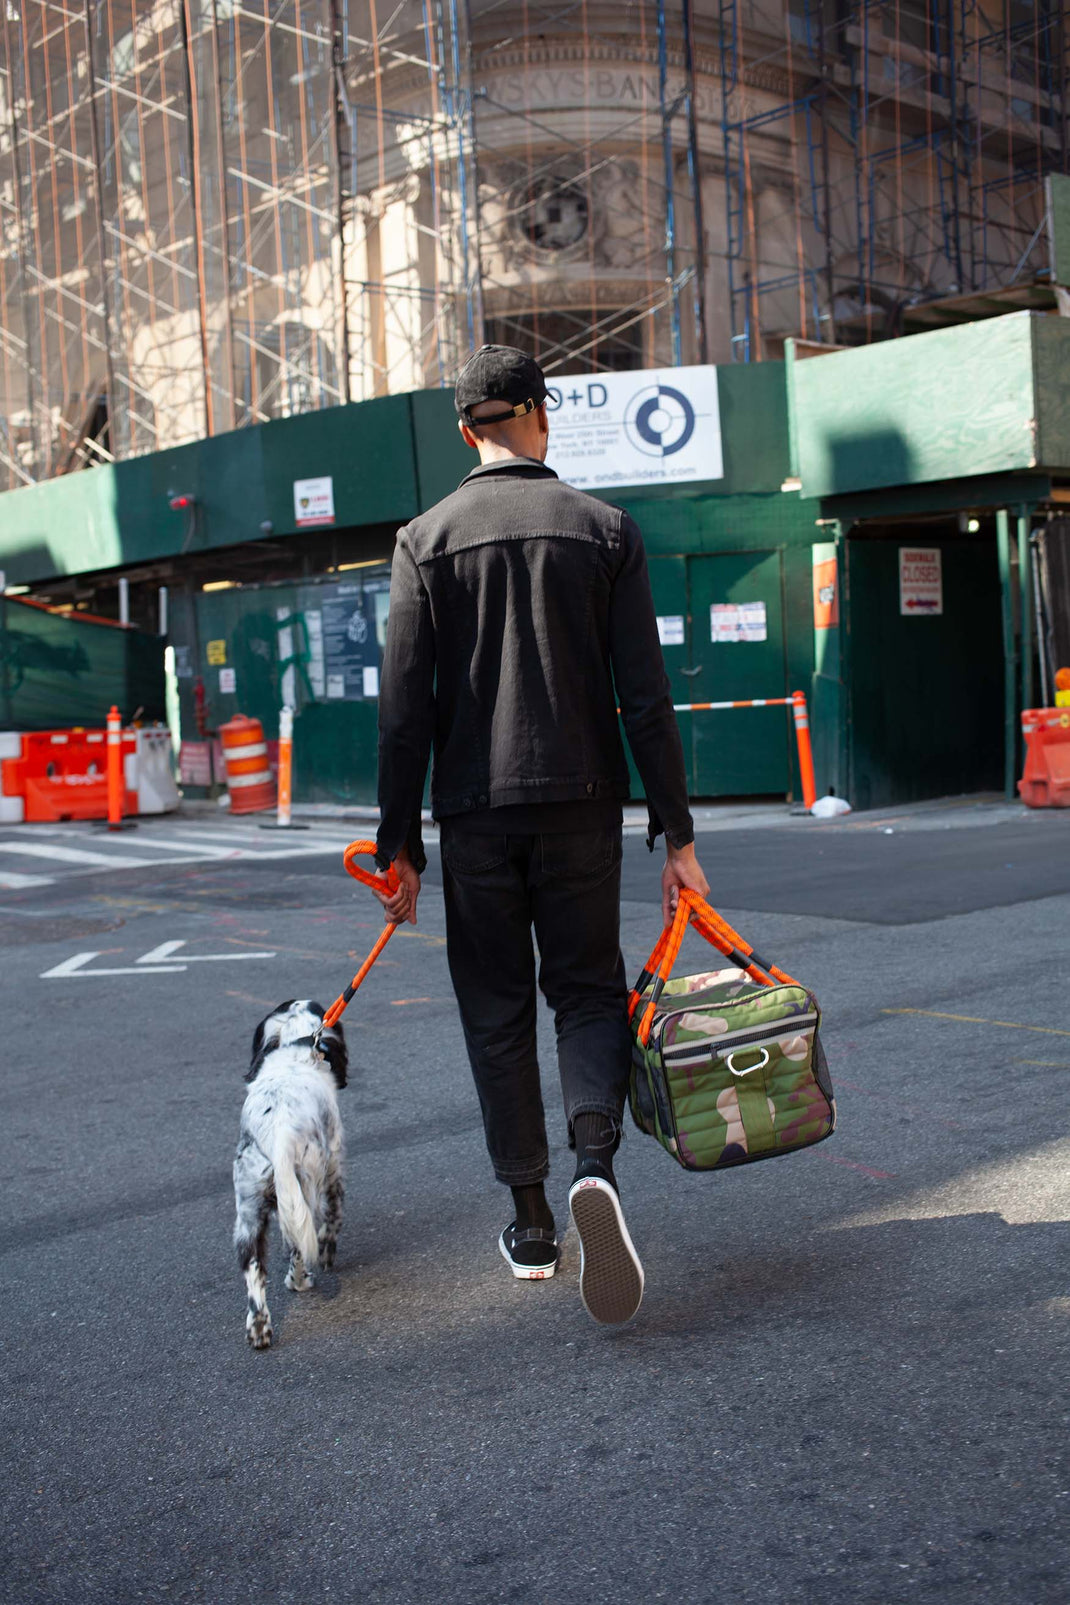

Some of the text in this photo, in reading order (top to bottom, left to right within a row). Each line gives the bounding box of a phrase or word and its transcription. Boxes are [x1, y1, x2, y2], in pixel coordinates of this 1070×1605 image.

[545, 383, 607, 411] O+D
[549, 410, 612, 425] UILDERS
[903, 565, 939, 583] CLOSED
